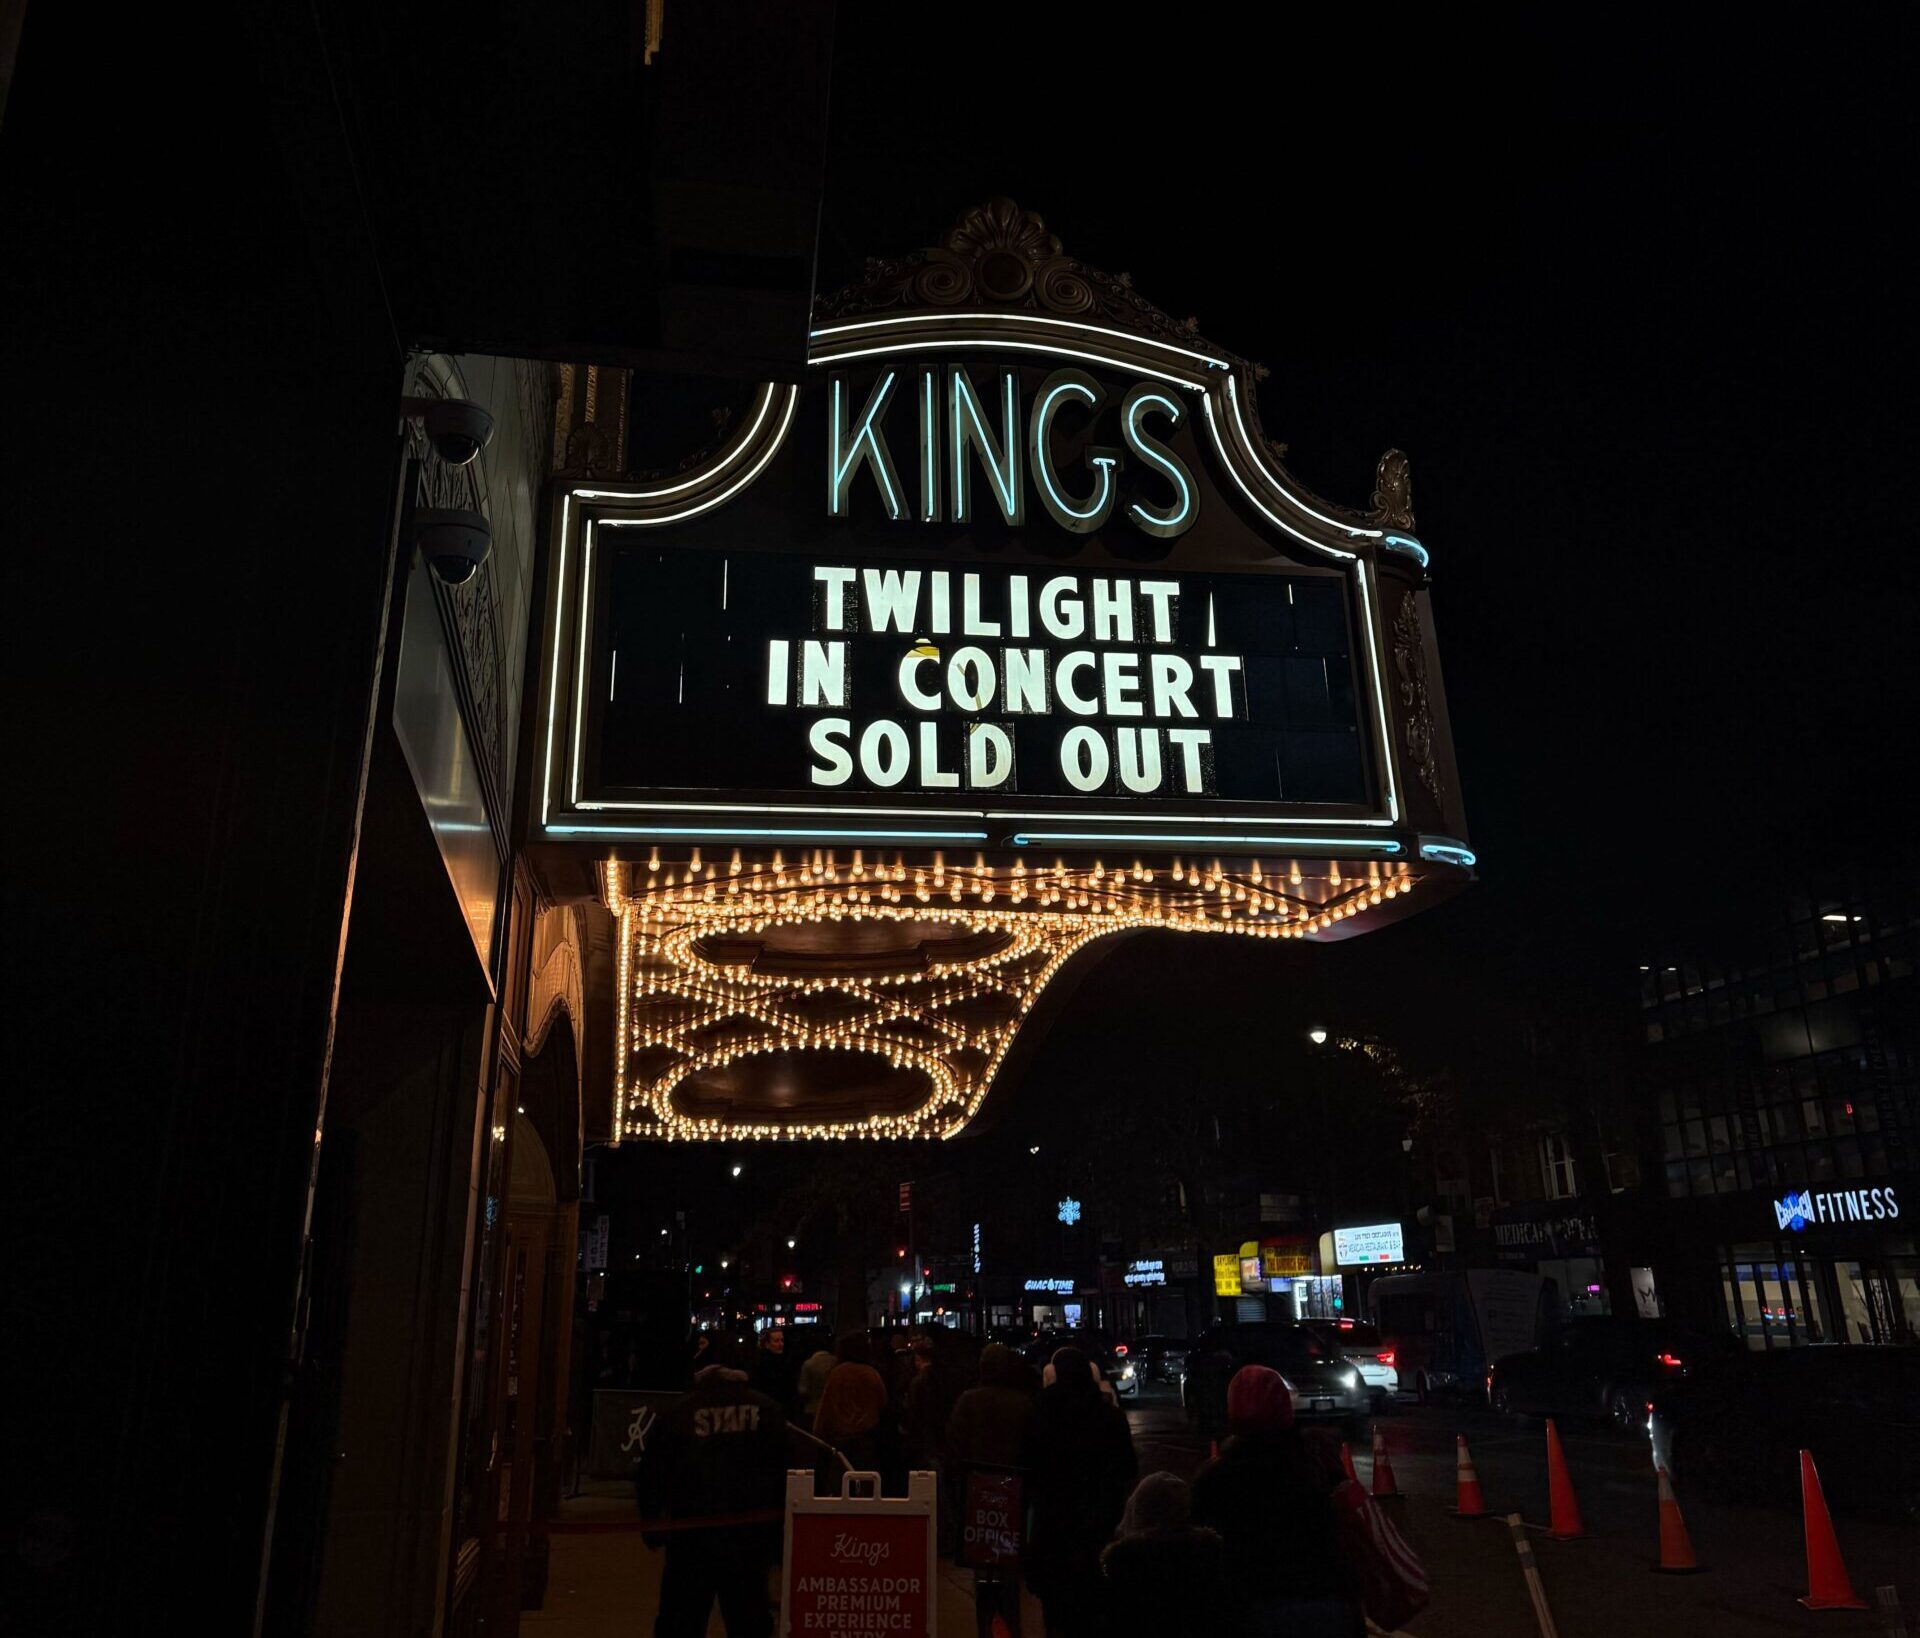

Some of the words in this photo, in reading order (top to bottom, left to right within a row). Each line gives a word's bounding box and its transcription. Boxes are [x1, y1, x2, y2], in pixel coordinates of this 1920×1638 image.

[828, 362, 1200, 538] KINGS
[814, 566, 1180, 644] TWILIGHT
[767, 639, 847, 707] IN
[898, 646, 1242, 719] CONCERT
[808, 717, 1013, 788] SOLD
[1060, 725, 1211, 794] OUT
[1816, 1186, 1899, 1224] FITNESS
[1054, 1279, 1075, 1291] TIME
[694, 1404, 760, 1437] STAFF
[976, 1509, 1008, 1528] BOX
[830, 1531, 890, 1567] Kings
[796, 1577, 921, 1594] AMBASSADOR
[816, 1595, 901, 1611] PREMIUM
[803, 1612, 913, 1629] EXPERIENCE
